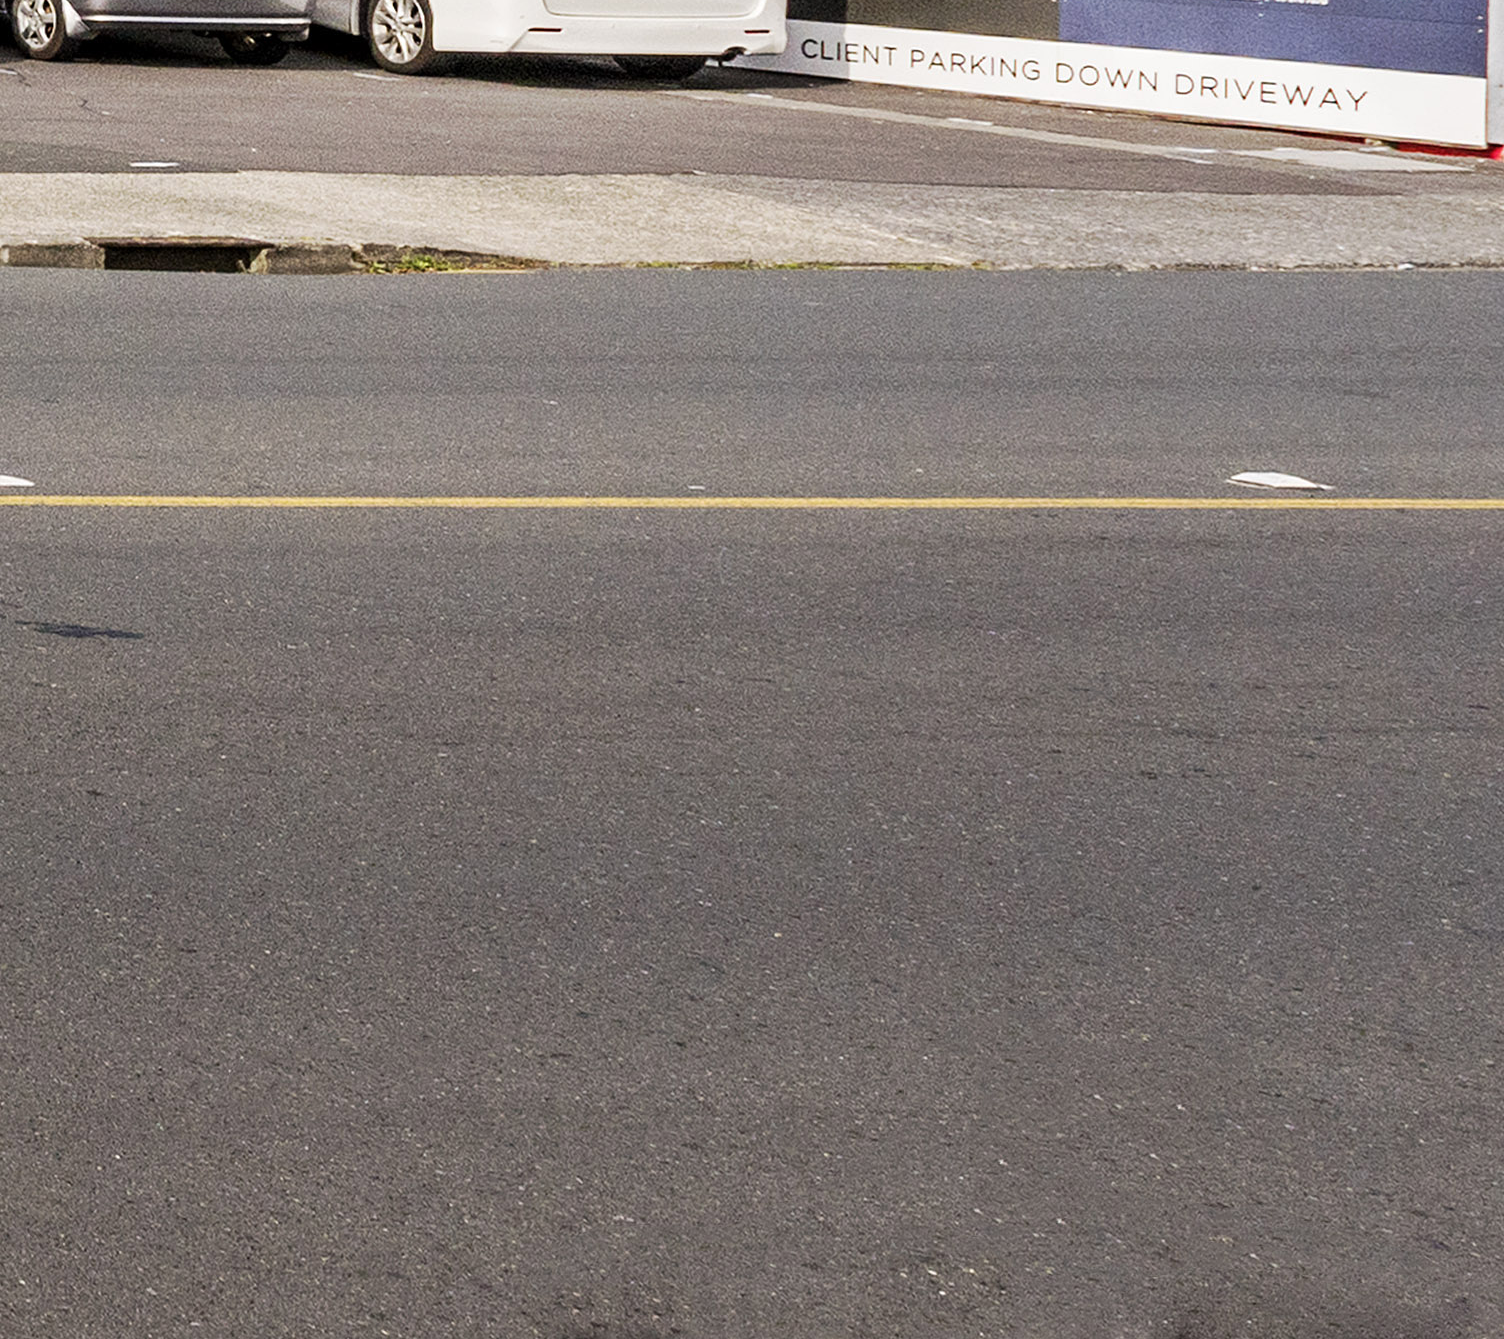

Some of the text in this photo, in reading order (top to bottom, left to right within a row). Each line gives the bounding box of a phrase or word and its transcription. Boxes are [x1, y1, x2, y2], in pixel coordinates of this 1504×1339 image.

[800, 38, 1369, 113] CLIENT PARKING DOWN DRIVEWAY
